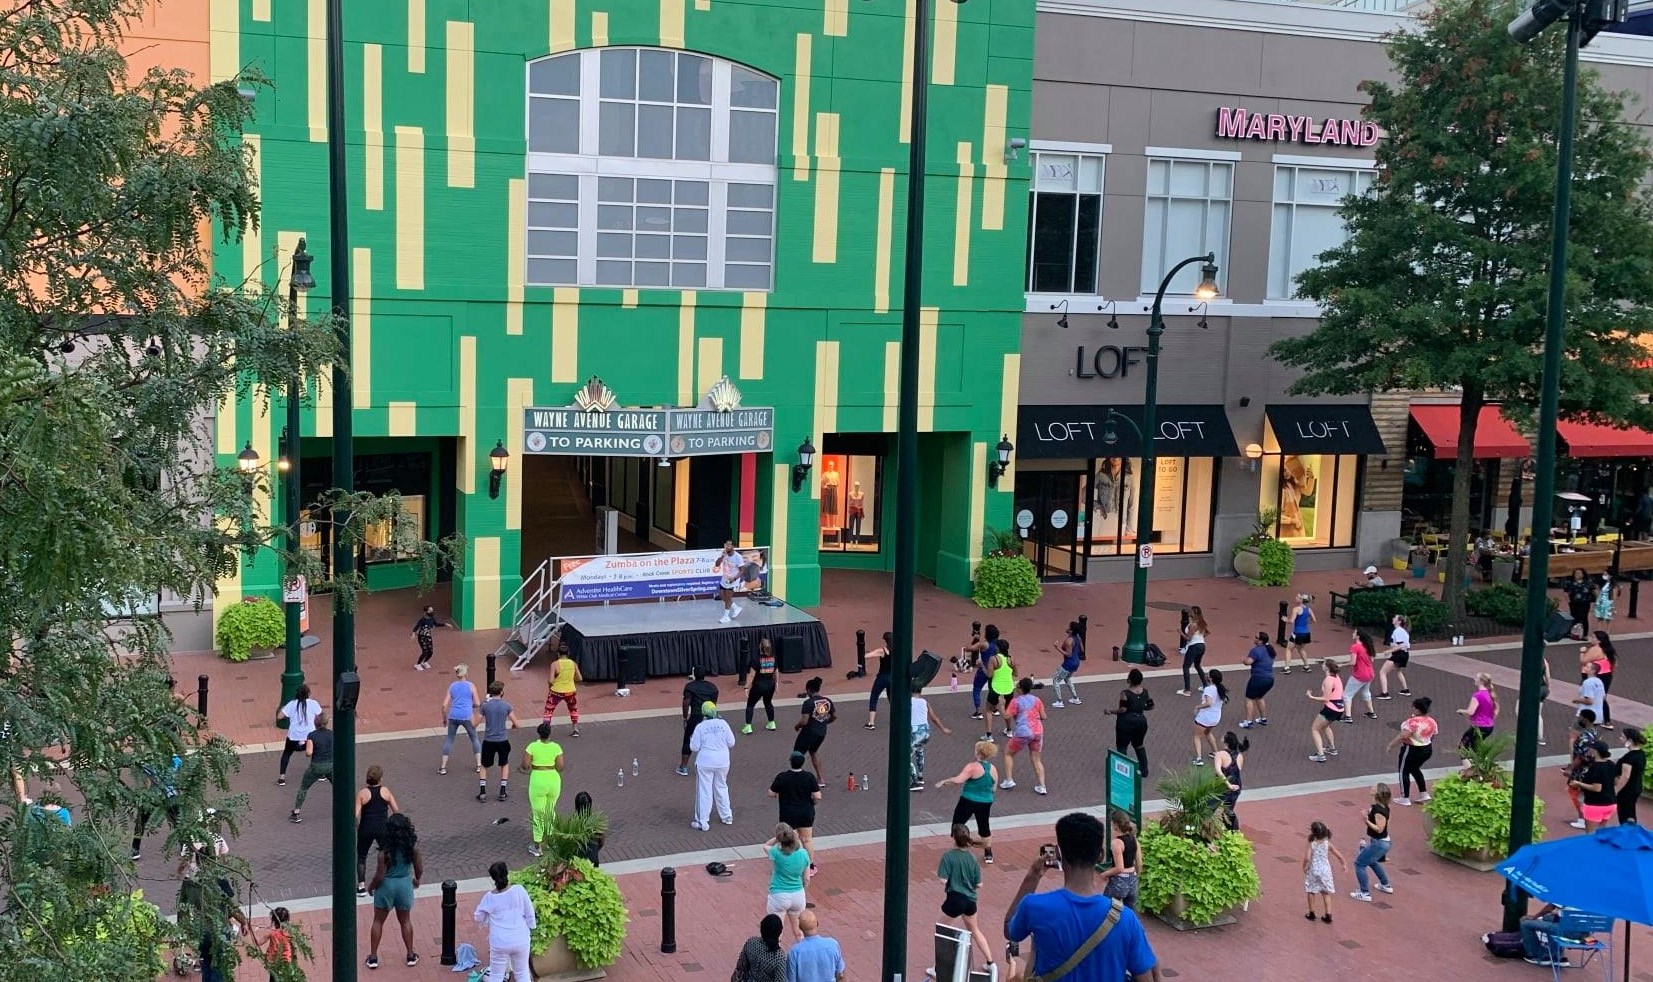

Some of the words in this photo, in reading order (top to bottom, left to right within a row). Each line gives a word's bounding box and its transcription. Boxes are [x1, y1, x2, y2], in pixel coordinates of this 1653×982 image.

[1217, 106, 1379, 146] MARYLAND
[1076, 345, 1163, 379] LOF
[533, 411, 568, 428] WAYNE
[573, 411, 611, 429] AVENUE
[617, 413, 658, 430] GARAGE
[676, 413, 702, 429] WAYNE
[706, 412, 734, 428] AVENUE
[738, 411, 767, 427] GARAGE
[1296, 420, 1350, 438] LOFT
[1034, 422, 1096, 441] LOFT
[550, 437, 571, 449] TO
[575, 437, 641, 449] PARKING
[688, 437, 704, 449] TO
[707, 435, 755, 447] PARKING
[605, 560, 637, 569] Zumba
[654, 558, 669, 566] the
[671, 556, 695, 565] Plaza
[576, 586, 601, 594] Adventist
[602, 585, 633, 593] HealthCare
[651, 585, 718, 595] DowntownSilverSpring.com
